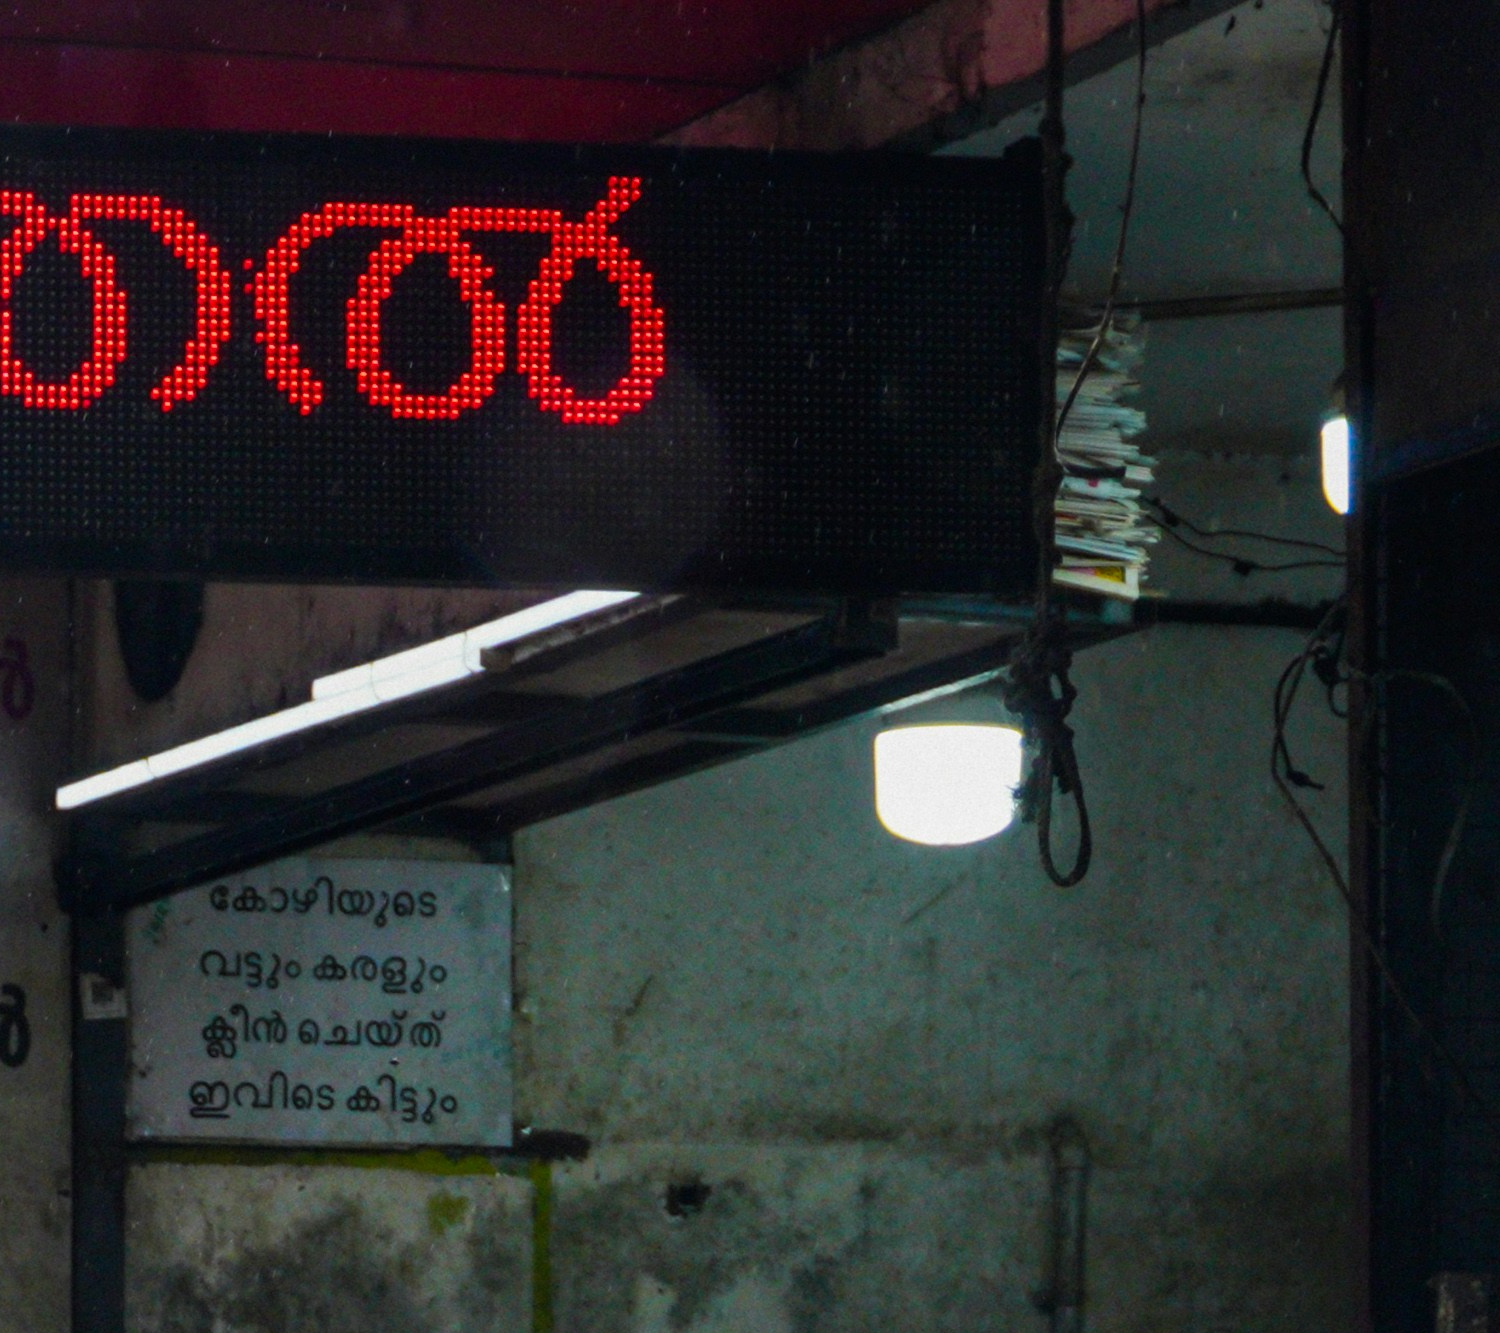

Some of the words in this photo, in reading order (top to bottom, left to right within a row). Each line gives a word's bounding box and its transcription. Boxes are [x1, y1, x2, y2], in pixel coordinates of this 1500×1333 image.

[209, 875, 438, 929] കോഴിയുടെ
[200, 949, 301, 991] വട്ടും
[312, 954, 449, 995] കരളും
[202, 1003, 289, 1060] ക്ലീൻ
[188, 1070, 337, 1120] ഇവിടെ
[346, 1073, 460, 1126] കിട്ടും
